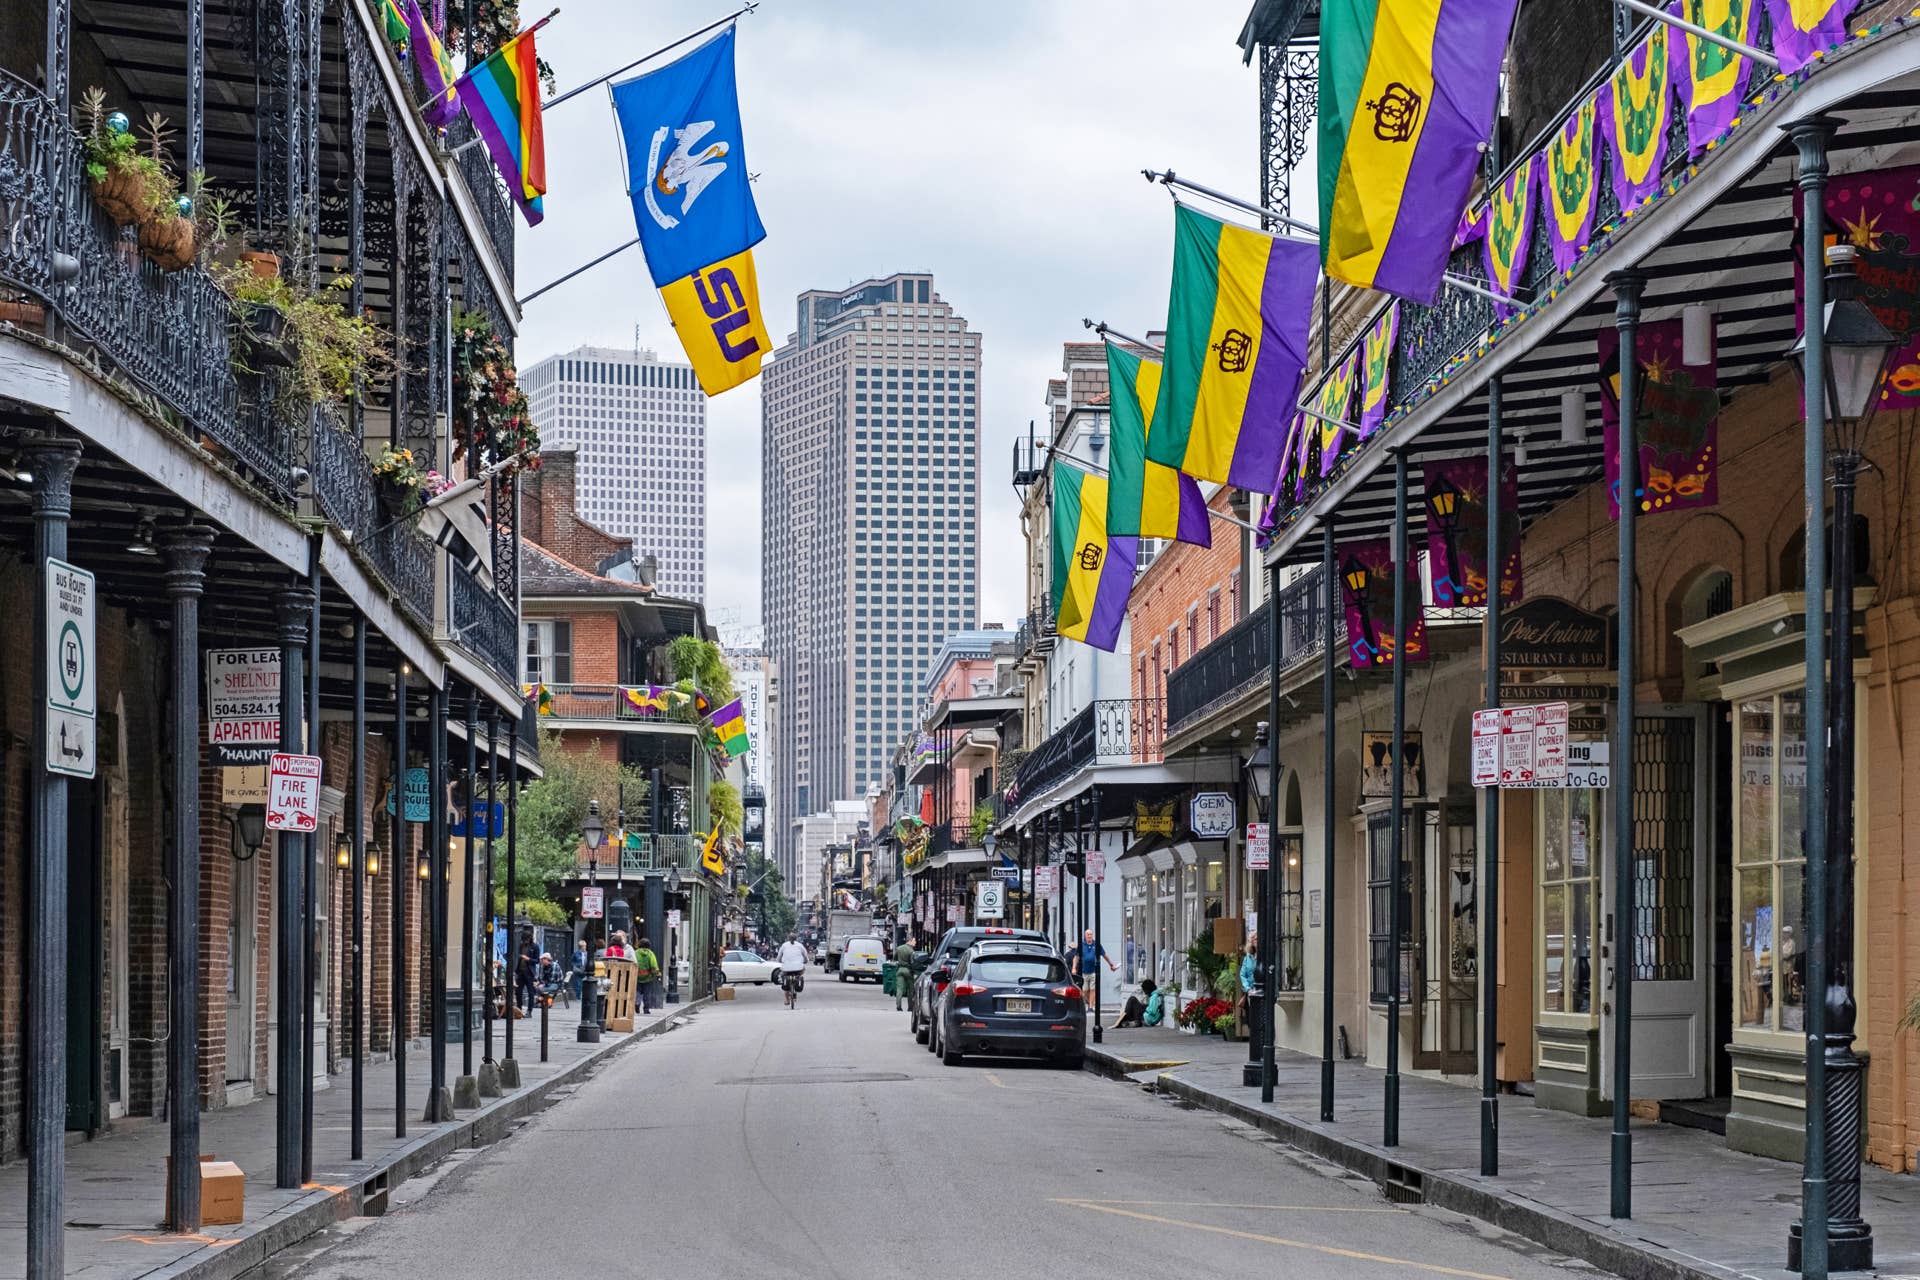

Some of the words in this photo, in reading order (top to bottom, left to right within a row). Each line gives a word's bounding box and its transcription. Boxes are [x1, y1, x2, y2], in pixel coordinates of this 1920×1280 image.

[691, 267, 760, 363] SU
[56, 573, 67, 588] BUS
[69, 577, 87, 596] ROUTE
[1528, 620, 1597, 643] Antoine
[217, 654, 248, 665] FOR
[1568, 652, 1577, 665] &
[1582, 652, 1604, 665] BAR
[1556, 686, 1576, 698] ALL
[1581, 686, 1600, 698] DAY
[750, 684, 758, 726] HOTEL
[1536, 708, 1546, 723] NO
[1544, 709, 1567, 720] STOPPING
[1480, 719, 1500, 728] PARKING
[1502, 717, 1512, 729] NO
[1511, 717, 1533, 726] STOPPING
[1546, 726, 1557, 735] TO
[1474, 736, 1497, 747] FREIGHT
[1538, 736, 1564, 746] CORNER
[1478, 748, 1493, 759] ZONE
[1510, 751, 1526, 759] STREET
[273, 758, 289, 772] NO
[290, 759, 318, 767] STOPPING
[1506, 758, 1530, 766] CLEANING
[1538, 756, 1564, 768] ANYTIME
[291, 766, 316, 774] ANYTIME
[1565, 772, 1608, 787] To-Go
[281, 779, 307, 793] FIRE
[278, 796, 308, 809] LANE
[1200, 798, 1225, 809] GEM
